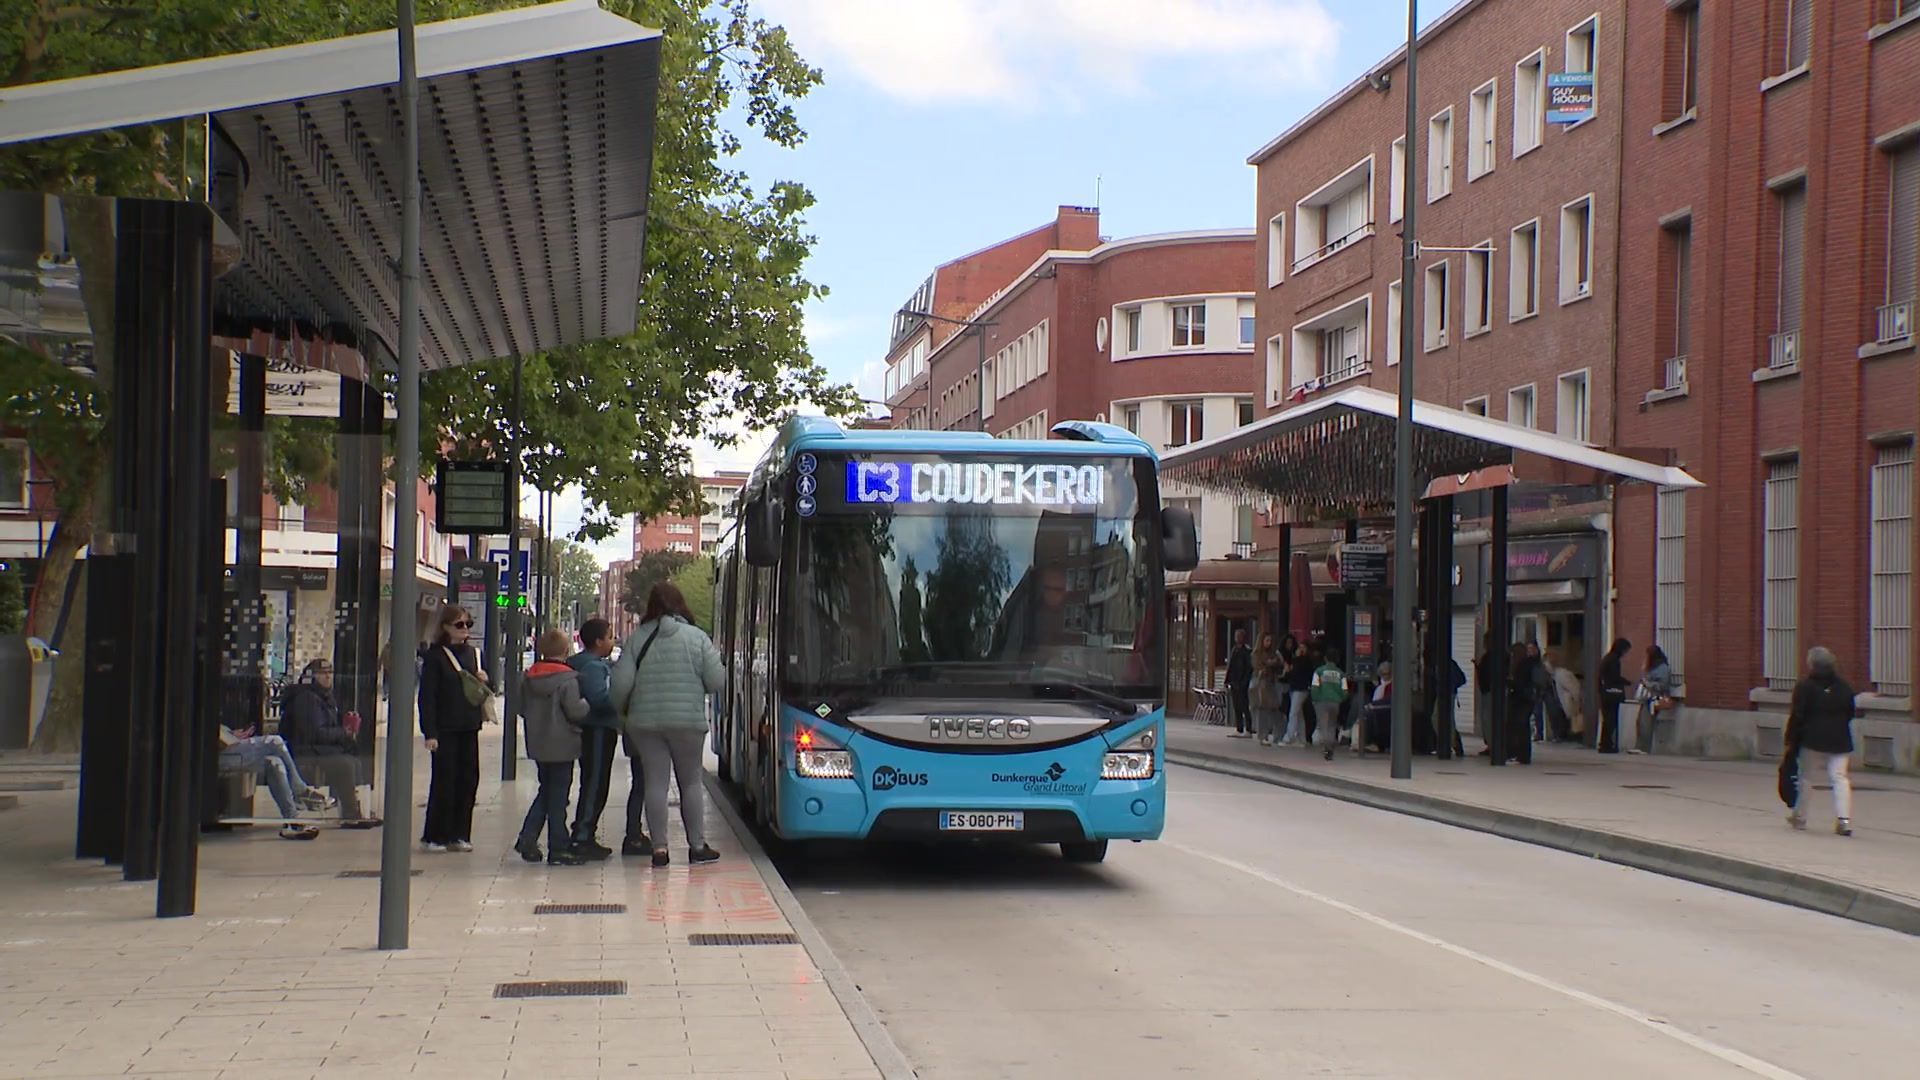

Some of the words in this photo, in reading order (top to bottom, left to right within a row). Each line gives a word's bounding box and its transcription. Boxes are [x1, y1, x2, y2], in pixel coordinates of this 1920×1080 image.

[1553, 87, 1575, 96] GUY
[1553, 94, 1592, 104] HOQUE
[856, 461, 900, 504] C3
[493, 552, 510, 580] P
[929, 717, 1032, 740] IVECO
[991, 773, 1049, 784] Dunkerque
[1024, 782, 1053, 792] Grand
[1053, 782, 1087, 792] Littoral
